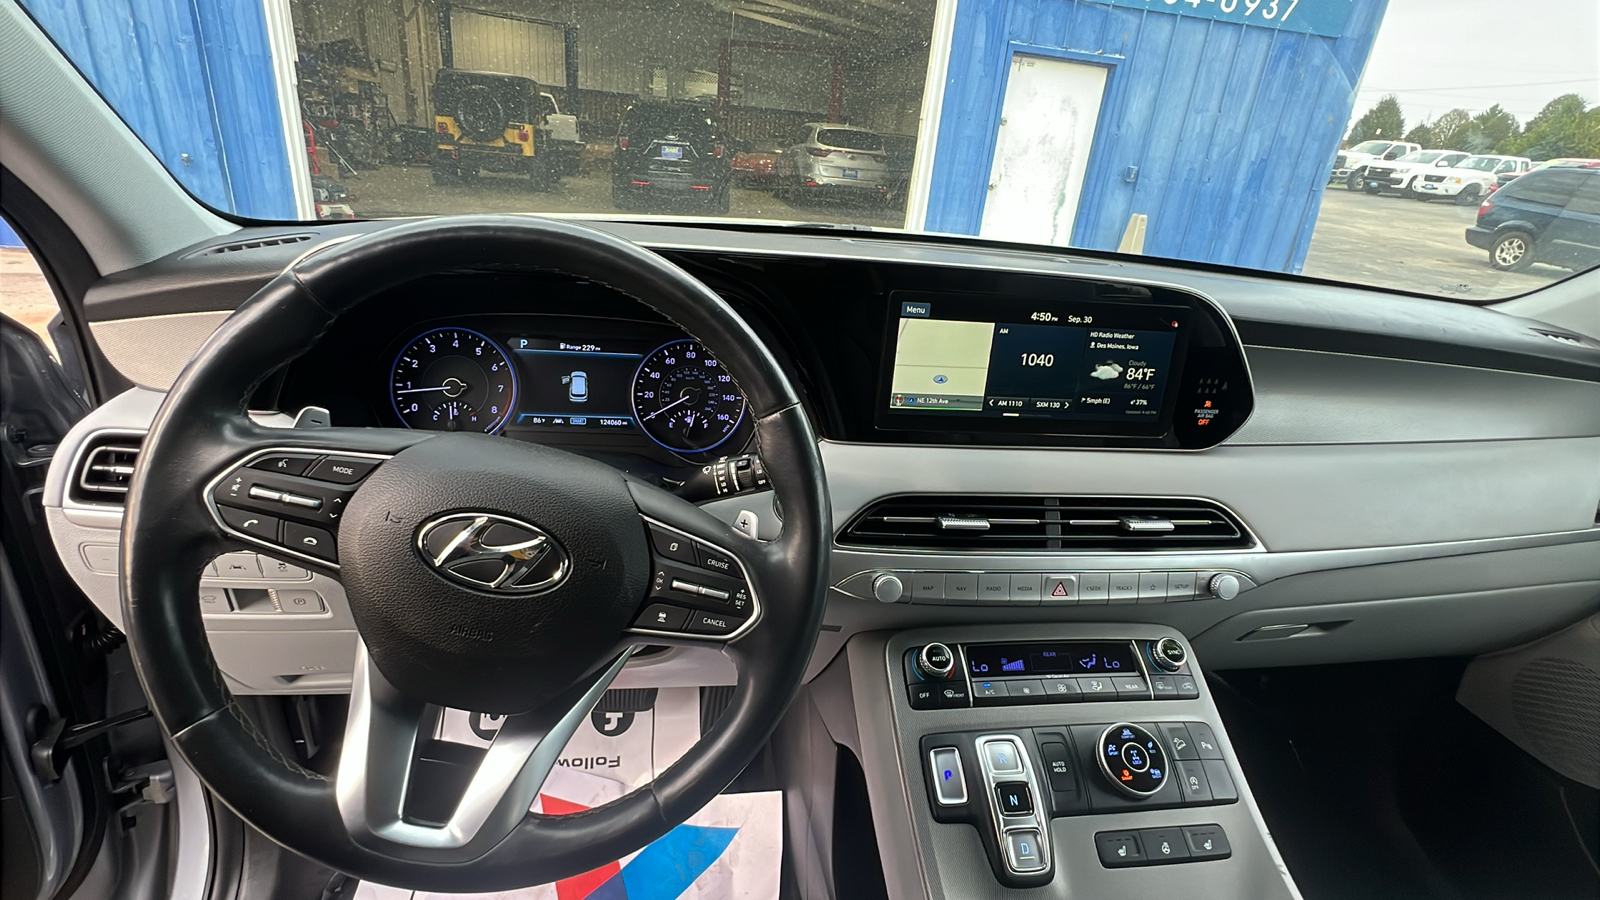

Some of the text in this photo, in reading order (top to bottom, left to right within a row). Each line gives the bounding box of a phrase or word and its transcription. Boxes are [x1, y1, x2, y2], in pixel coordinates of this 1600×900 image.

[906, 305, 926, 314] Menu
[1030, 312, 1052, 322] 4:50
[1067, 315, 1082, 324] Sep.
[452, 340, 459, 348] 4
[520, 339, 528, 348] P
[566, 344, 581, 352] Range
[429, 344, 436, 353] 3
[475, 347, 482, 356] 5
[686, 351, 696, 359] 80
[411, 360, 418, 368] 2
[665, 357, 676, 365] 60
[704, 359, 717, 367] 100
[1021, 353, 1054, 367] 1040
[1128, 360, 1147, 368] Cloudy
[491, 363, 498, 372] 6
[649, 371, 660, 379] 40
[1126, 368, 1156, 381] 84°F
[406, 381, 411, 389] 1
[497, 384, 504, 393] 7
[722, 394, 735, 402] 140
[1086, 397, 1102, 405] 5mph
[411, 403, 418, 411] 0
[491, 405, 498, 414] 8
[717, 413, 730, 421] 160
[1197, 418, 1210, 426] OFF
[333, 466, 354, 475] MODE
[707, 557, 730, 570] CRUISE
[736, 592, 747, 600] RES
[735, 599, 745, 607] SET
[702, 617, 727, 628] CANCEL
[451, 625, 493, 642] AIRBAG
[556, 755, 621, 770] Follow
[998, 753, 1007, 764] R
[944, 769, 953, 781] P
[1009, 794, 1019, 806] N
[1020, 842, 1030, 855] D
